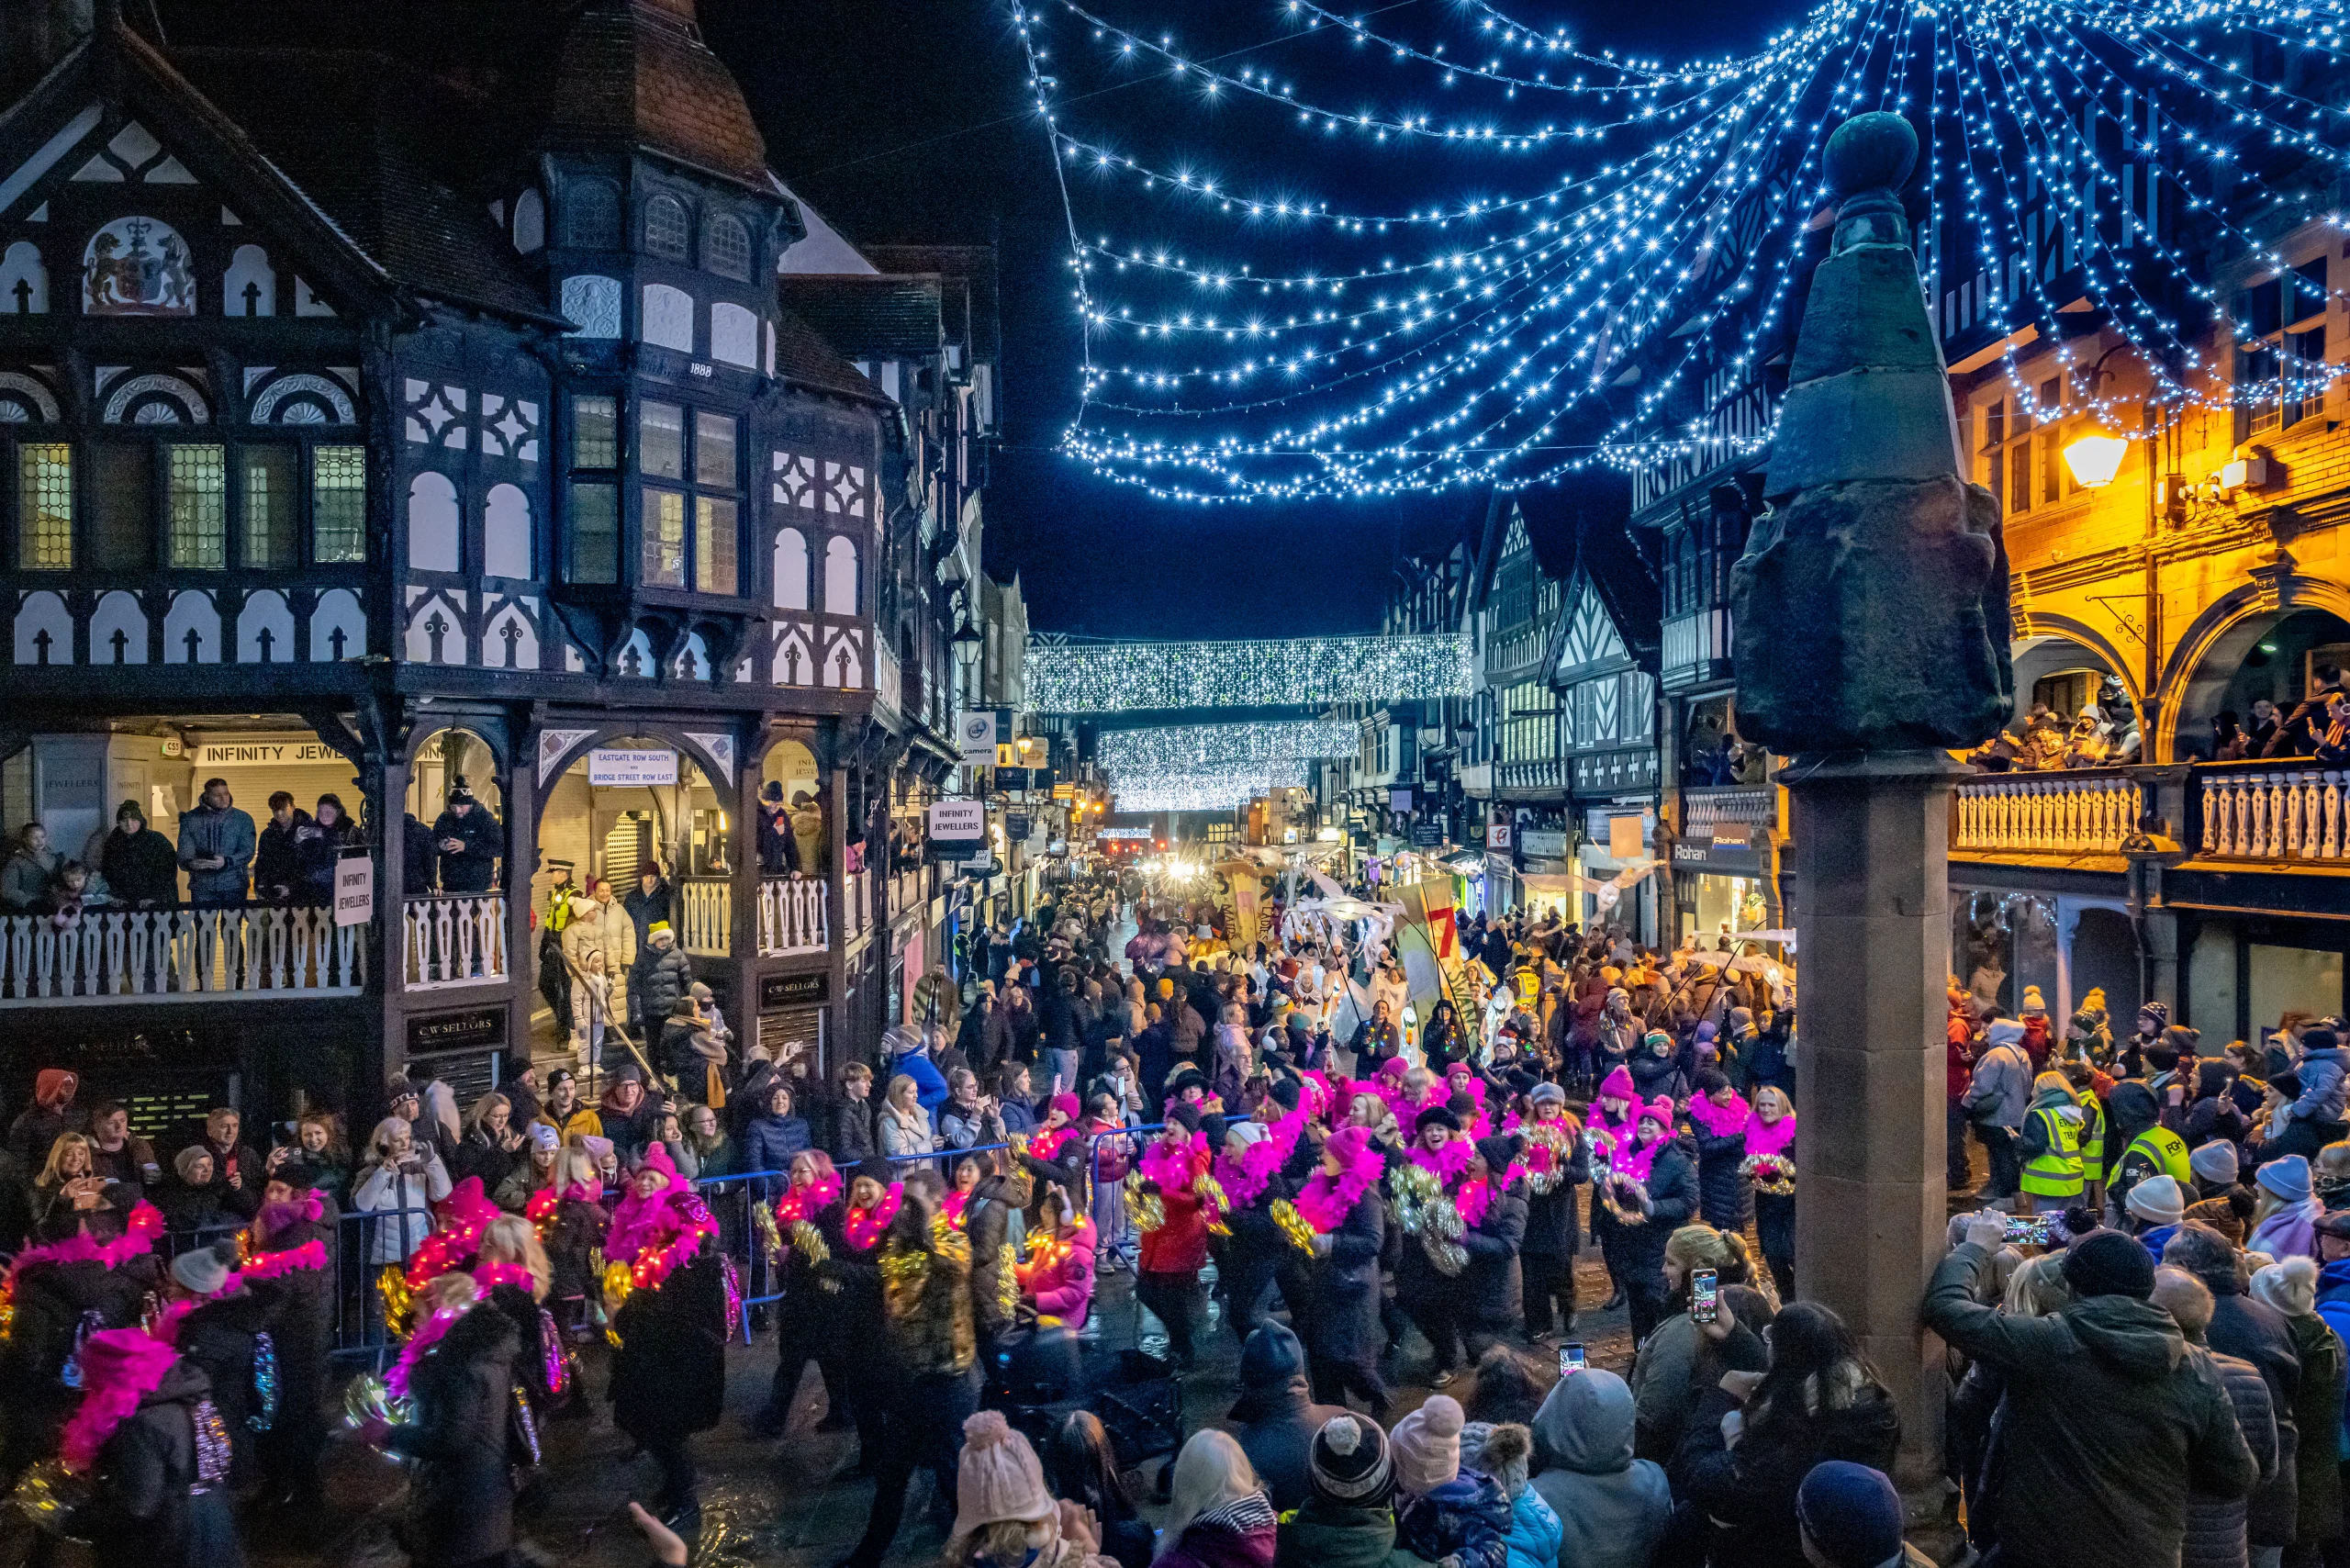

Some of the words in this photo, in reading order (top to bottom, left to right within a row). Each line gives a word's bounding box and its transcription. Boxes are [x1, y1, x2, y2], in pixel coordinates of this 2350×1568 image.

[690, 363, 711, 377] 1888
[167, 742, 179, 750] CSS
[207, 746, 284, 761] INFINITY
[939, 810, 973, 818] INFINITY
[934, 822, 979, 831] JEWELLERS
[1675, 844, 1706, 860] Rohan
[342, 872, 366, 887] INFINITY
[1260, 875, 1275, 902] 9
[339, 894, 369, 910] JEWELLERS
[1222, 903, 1237, 940] MAIDS
[1259, 906, 1272, 940] LADIES
[1426, 906, 1457, 959] 7
[785, 980, 820, 991] SELLORS
[442, 1019, 491, 1033] SELLORS
